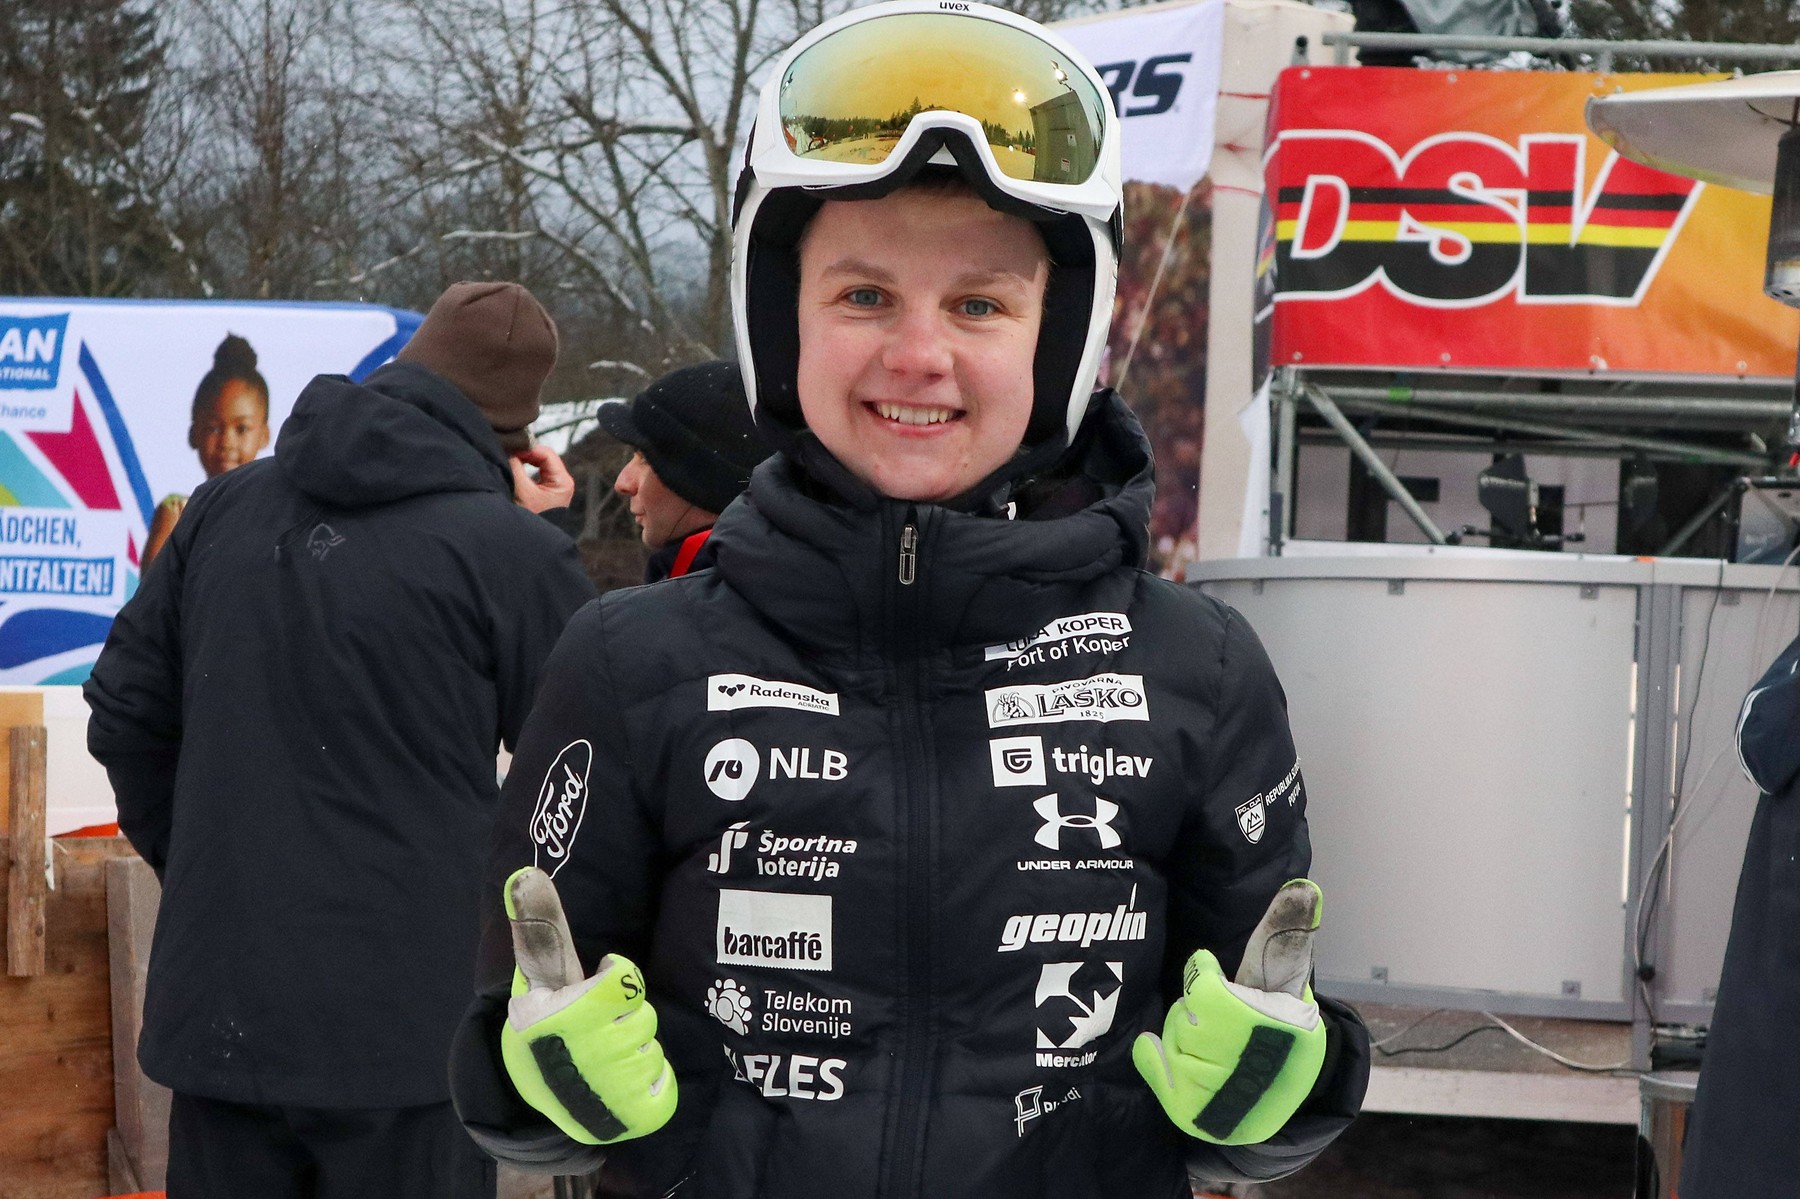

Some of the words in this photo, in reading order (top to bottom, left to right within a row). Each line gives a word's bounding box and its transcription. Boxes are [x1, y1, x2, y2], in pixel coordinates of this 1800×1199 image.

[939, 1, 970, 11] uvex
[1262, 129, 1706, 309] DSV
[0, 367, 51, 381] TIONAL
[1057, 616, 1125, 635] KOPER
[1049, 640, 1069, 661] of
[1074, 636, 1130, 655] Koper
[749, 684, 830, 707] Radenska
[1052, 677, 1123, 694] PIVOVARNA
[797, 701, 830, 711] ADRIATIC
[1036, 687, 1143, 718] LAŠKO
[1080, 710, 1104, 720] 1825
[769, 747, 848, 781] NLB
[1052, 745, 1153, 785] triglav
[533, 763, 583, 858] Ford
[757, 829, 858, 856] Športna
[756, 856, 840, 882] loterija
[1017, 860, 1071, 871] UNDER
[1075, 859, 1134, 870] ARMOUR
[997, 882, 1147, 952] geoplin
[724, 926, 822, 961] barcaffé
[764, 990, 852, 1015] Telekom
[761, 1013, 851, 1039] Slovenije
